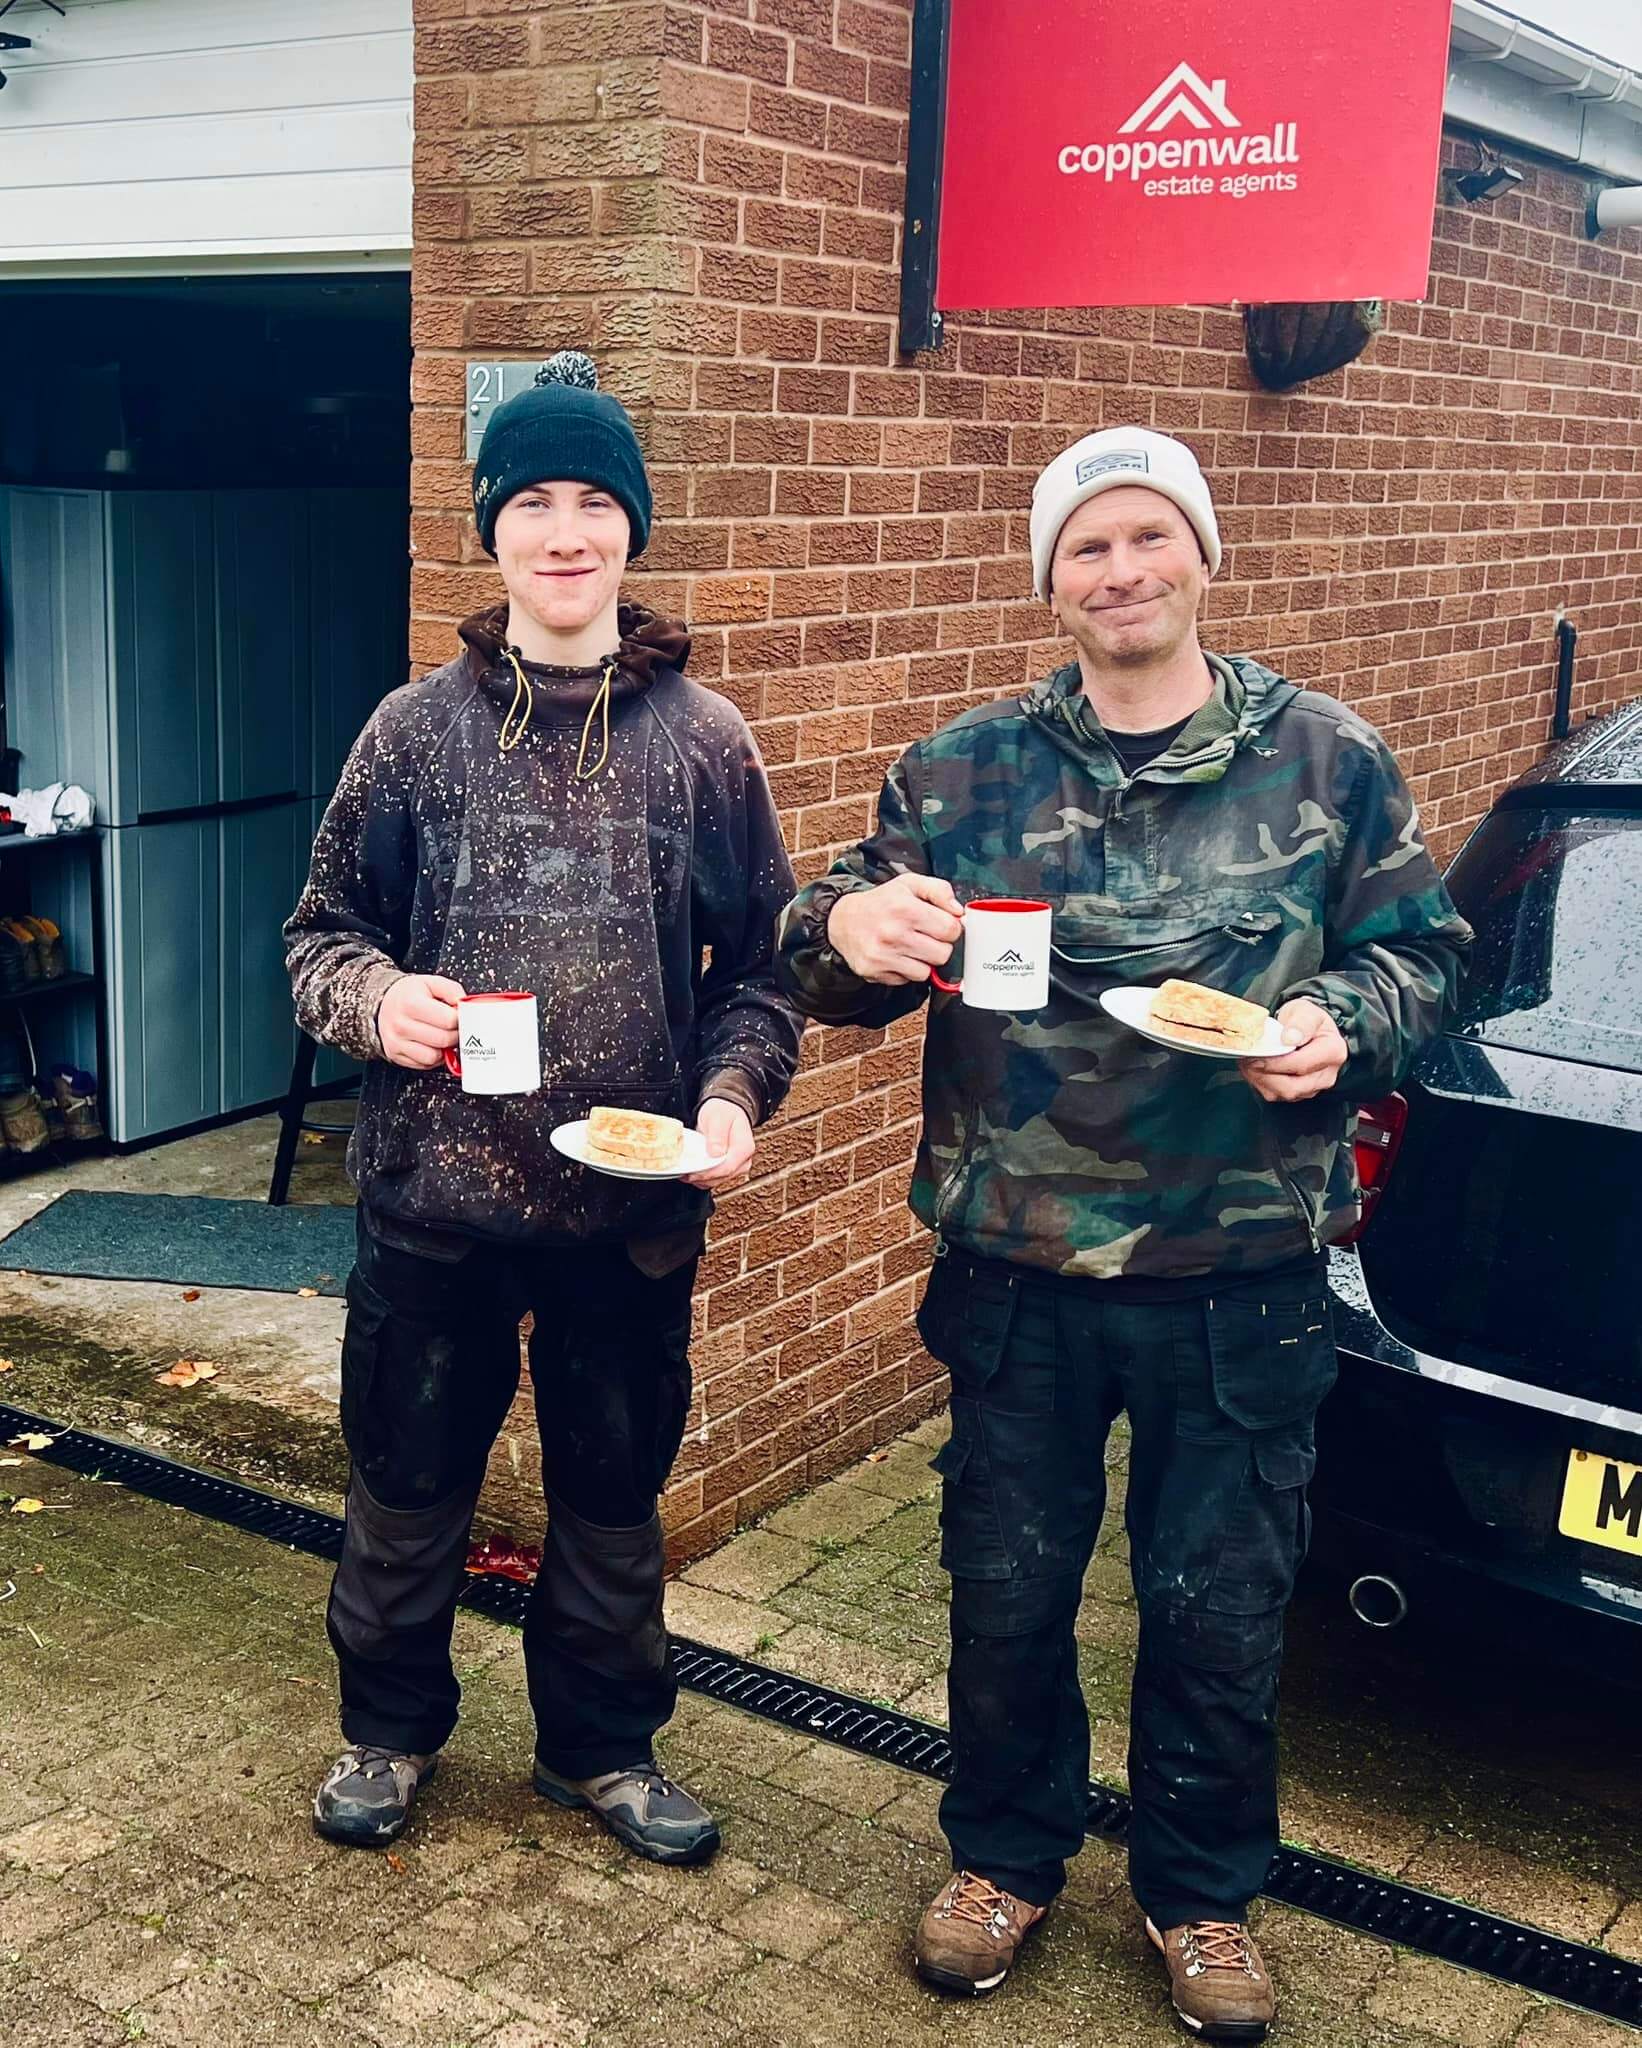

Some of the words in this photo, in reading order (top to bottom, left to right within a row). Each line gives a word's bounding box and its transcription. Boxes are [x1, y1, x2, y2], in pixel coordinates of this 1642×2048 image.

[1057, 122, 1299, 182] coppenwall
[1143, 175, 1214, 197] estate
[1219, 170, 1298, 198] agents
[471, 366, 505, 403] 21
[1596, 1463, 1642, 1538] M
